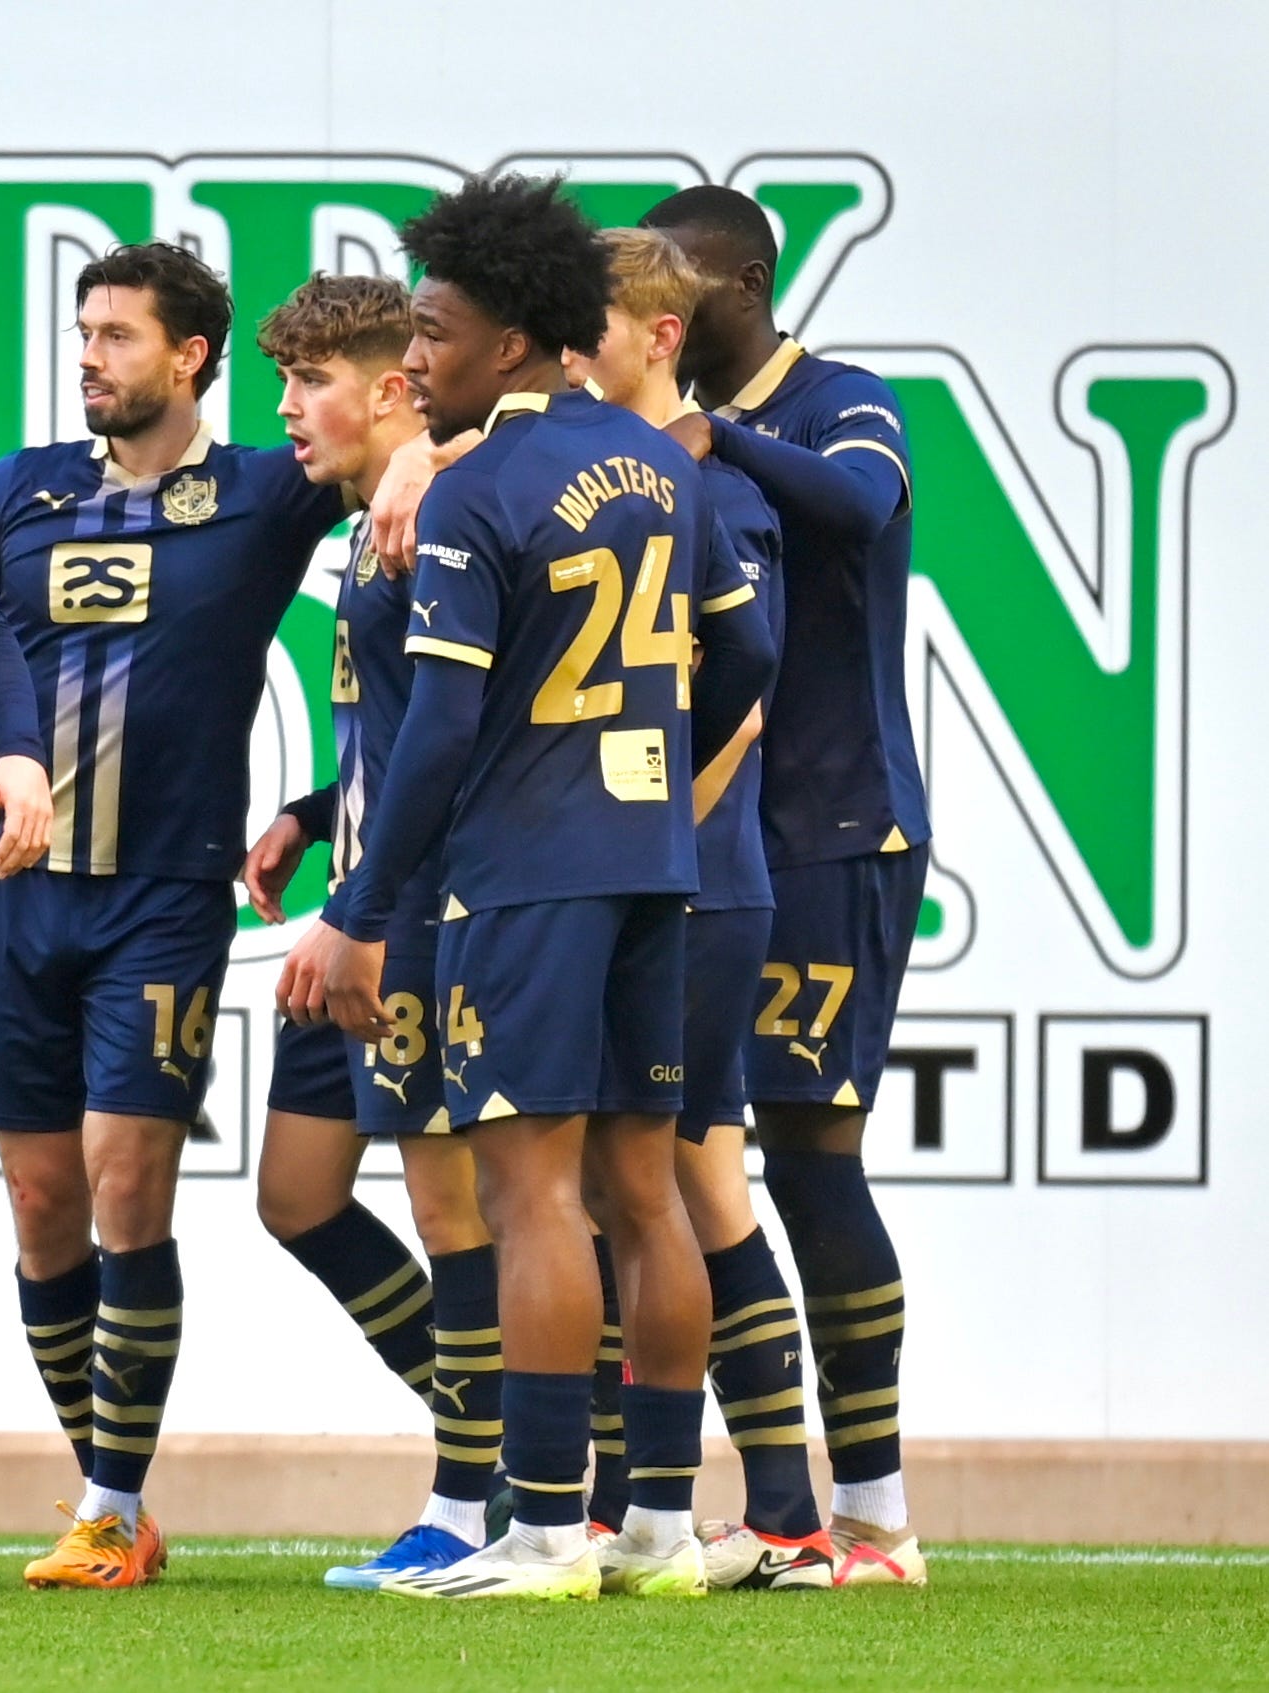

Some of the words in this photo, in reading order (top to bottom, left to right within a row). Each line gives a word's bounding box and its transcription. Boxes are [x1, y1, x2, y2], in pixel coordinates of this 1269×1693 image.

[552, 456, 675, 533] WALTERS
[531, 535, 693, 724] 24
[143, 983, 214, 1059] 16
[755, 962, 854, 1038] 27
